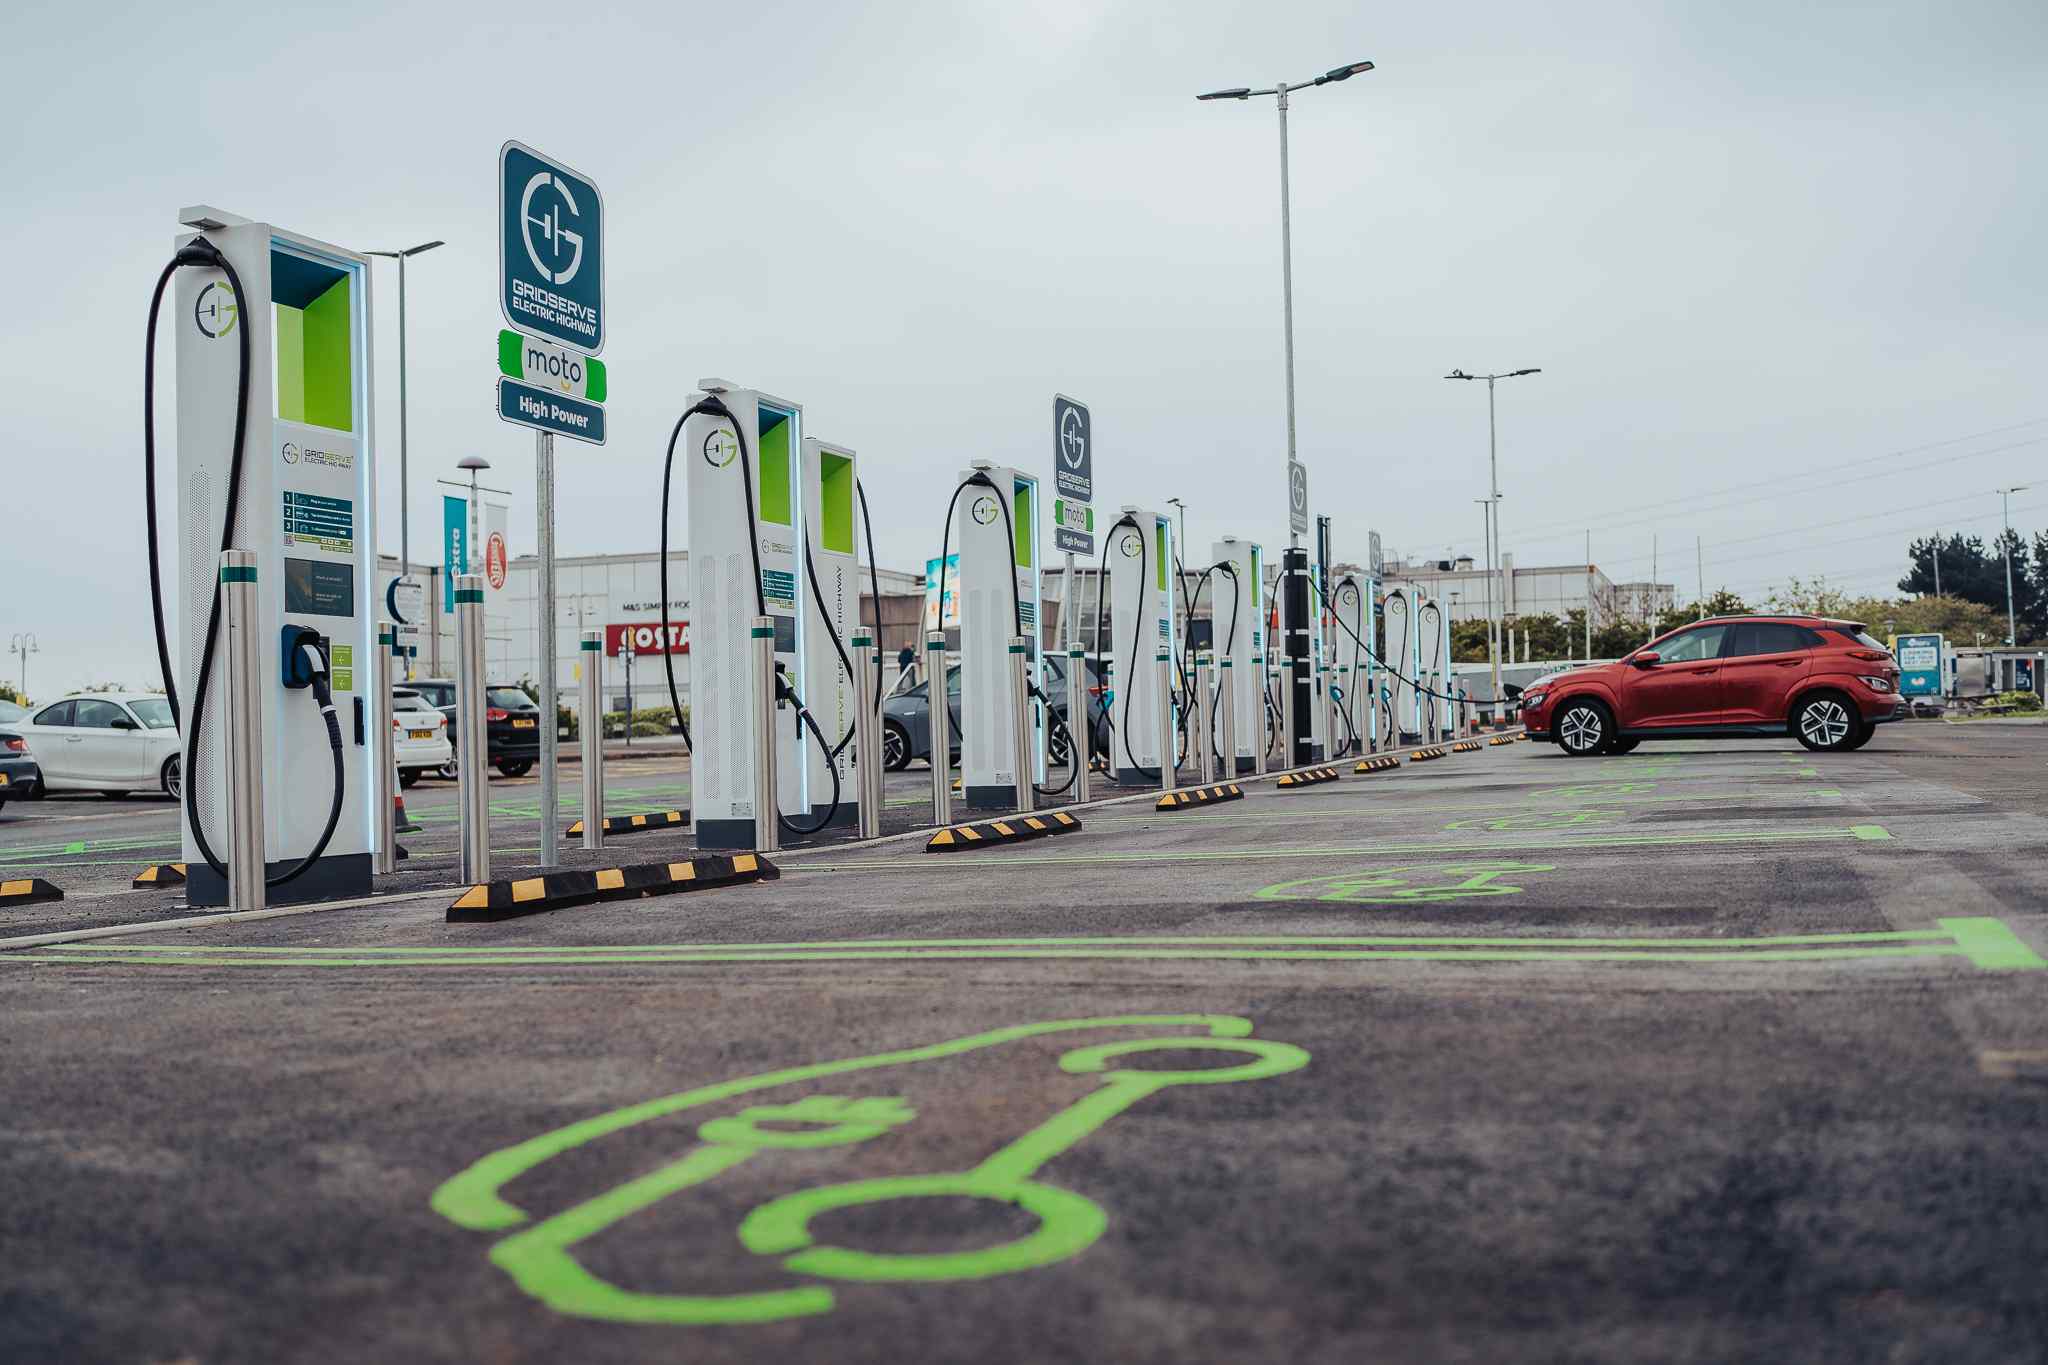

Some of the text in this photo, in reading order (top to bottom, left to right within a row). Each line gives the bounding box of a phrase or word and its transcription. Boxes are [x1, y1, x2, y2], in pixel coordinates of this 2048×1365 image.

[512, 278, 597, 324] GRIDSERVE
[512, 295, 597, 337] ELECTRIC HIGHWAY
[528, 347, 582, 383] moto
[519, 395, 589, 429] High Power
[304, 448, 352, 464] GRIDSERVE
[1058, 470, 1091, 488] GRIDSERVE
[1065, 506, 1085, 524] moto
[1062, 534, 1075, 547] High
[642, 602, 672, 611] SIMPY
